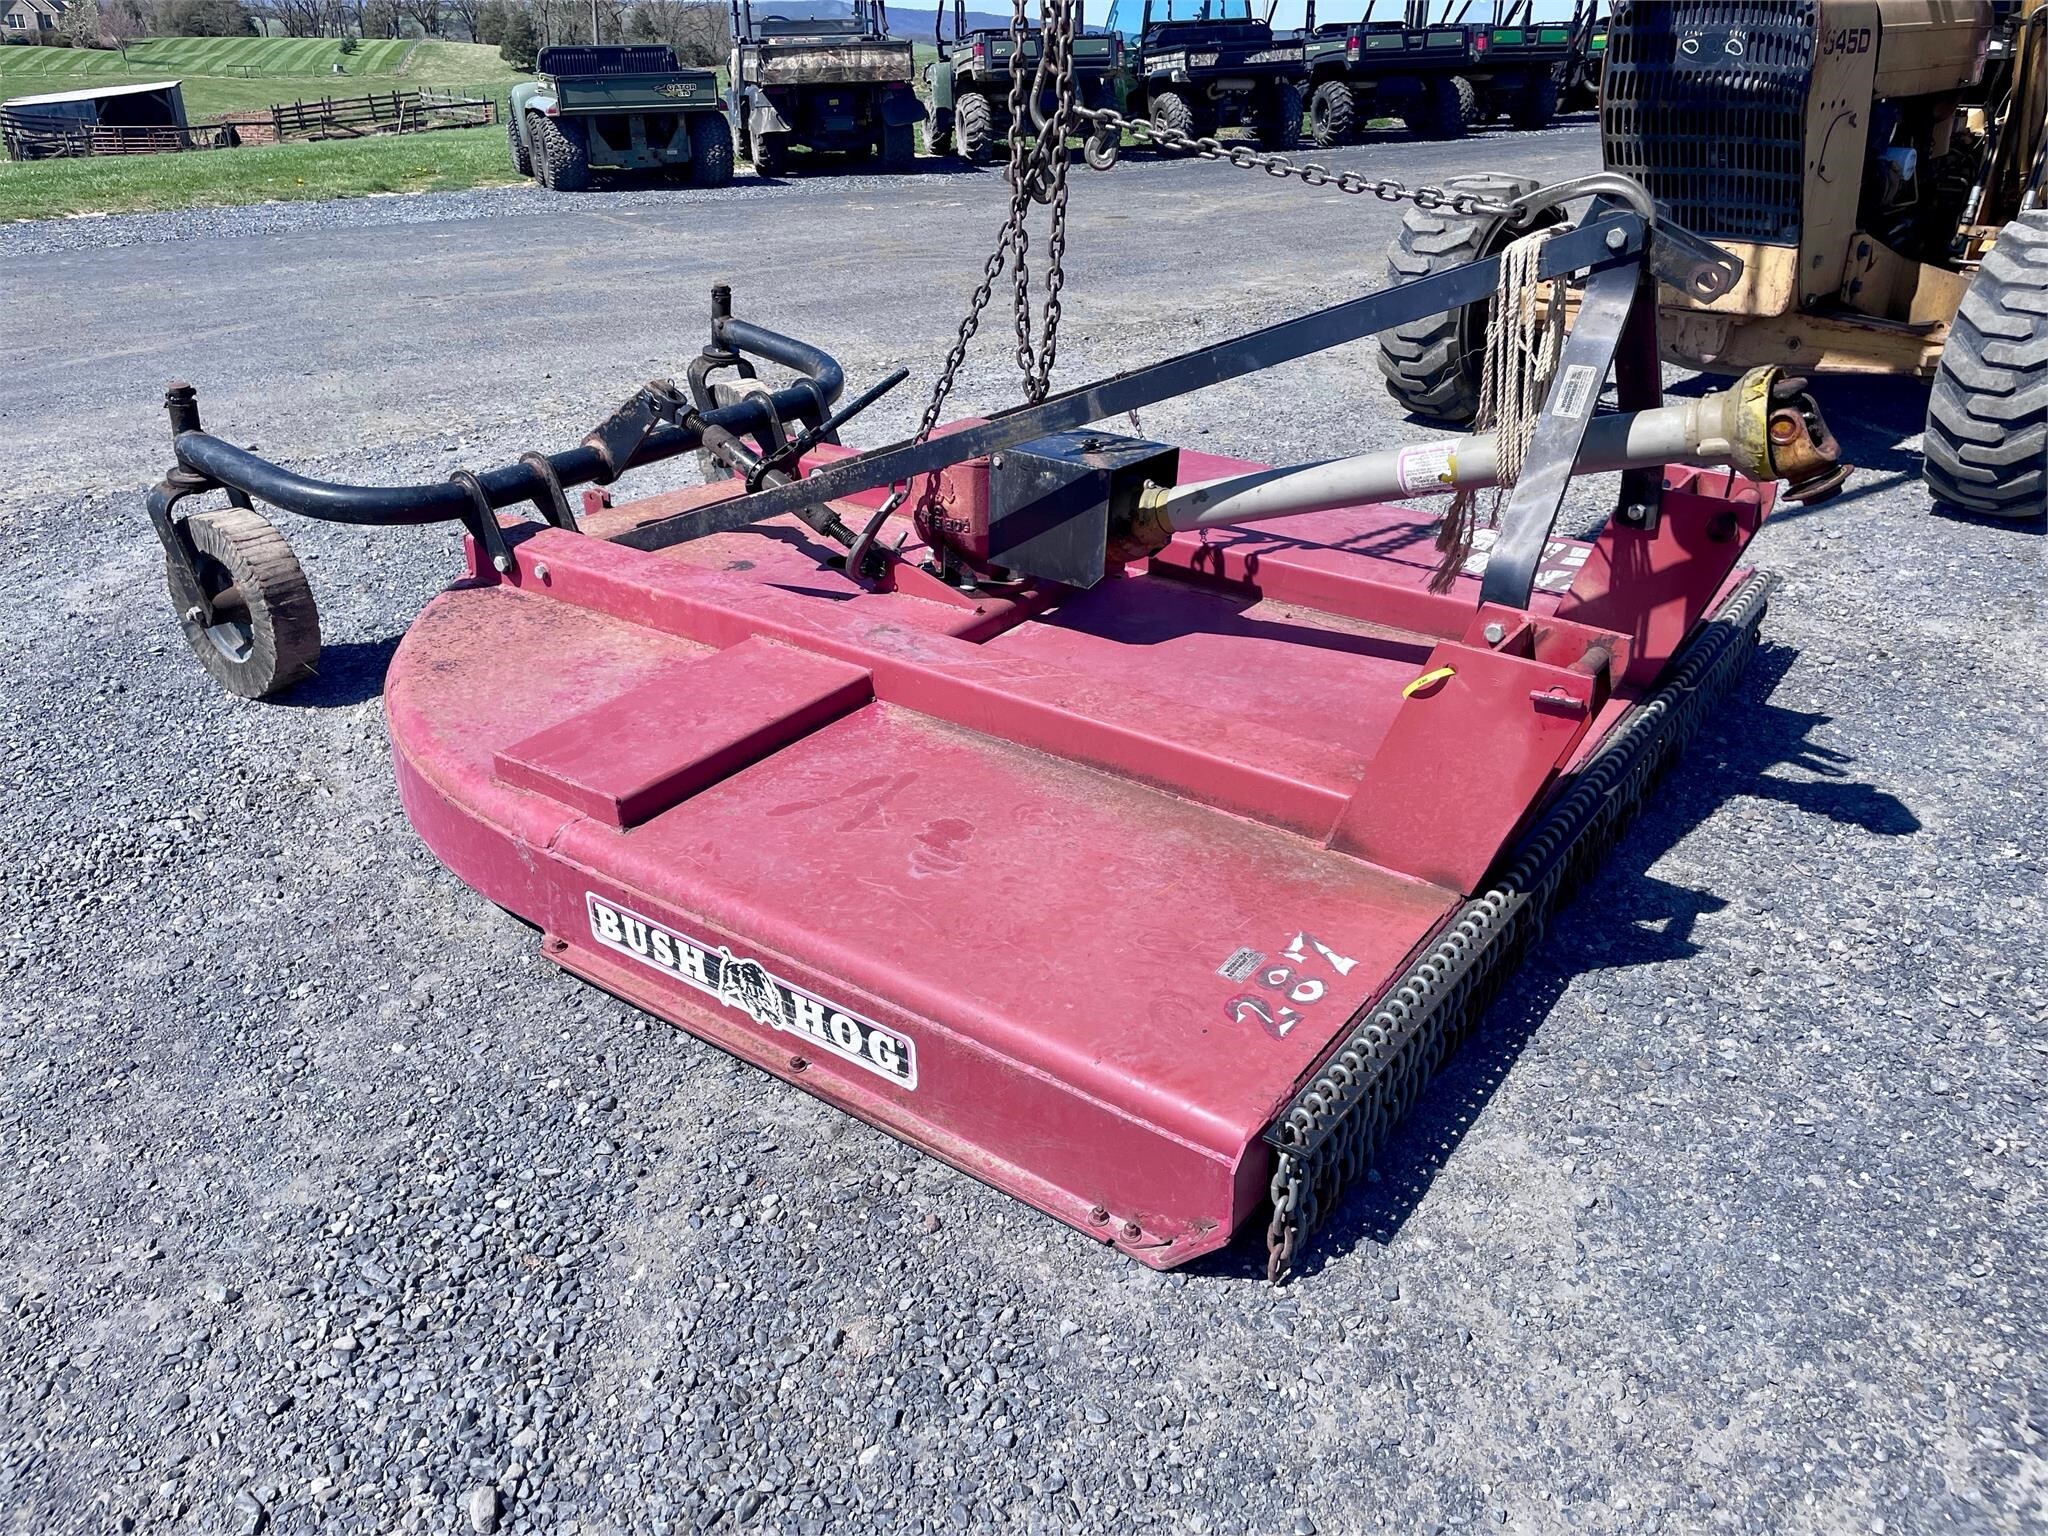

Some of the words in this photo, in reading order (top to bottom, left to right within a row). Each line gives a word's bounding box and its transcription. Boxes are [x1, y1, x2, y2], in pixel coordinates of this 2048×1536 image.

[667, 83, 697, 91] GATOR
[592, 902, 712, 985] BUSH
[1224, 931, 1360, 1041] 287
[789, 993, 901, 1075] HOG
